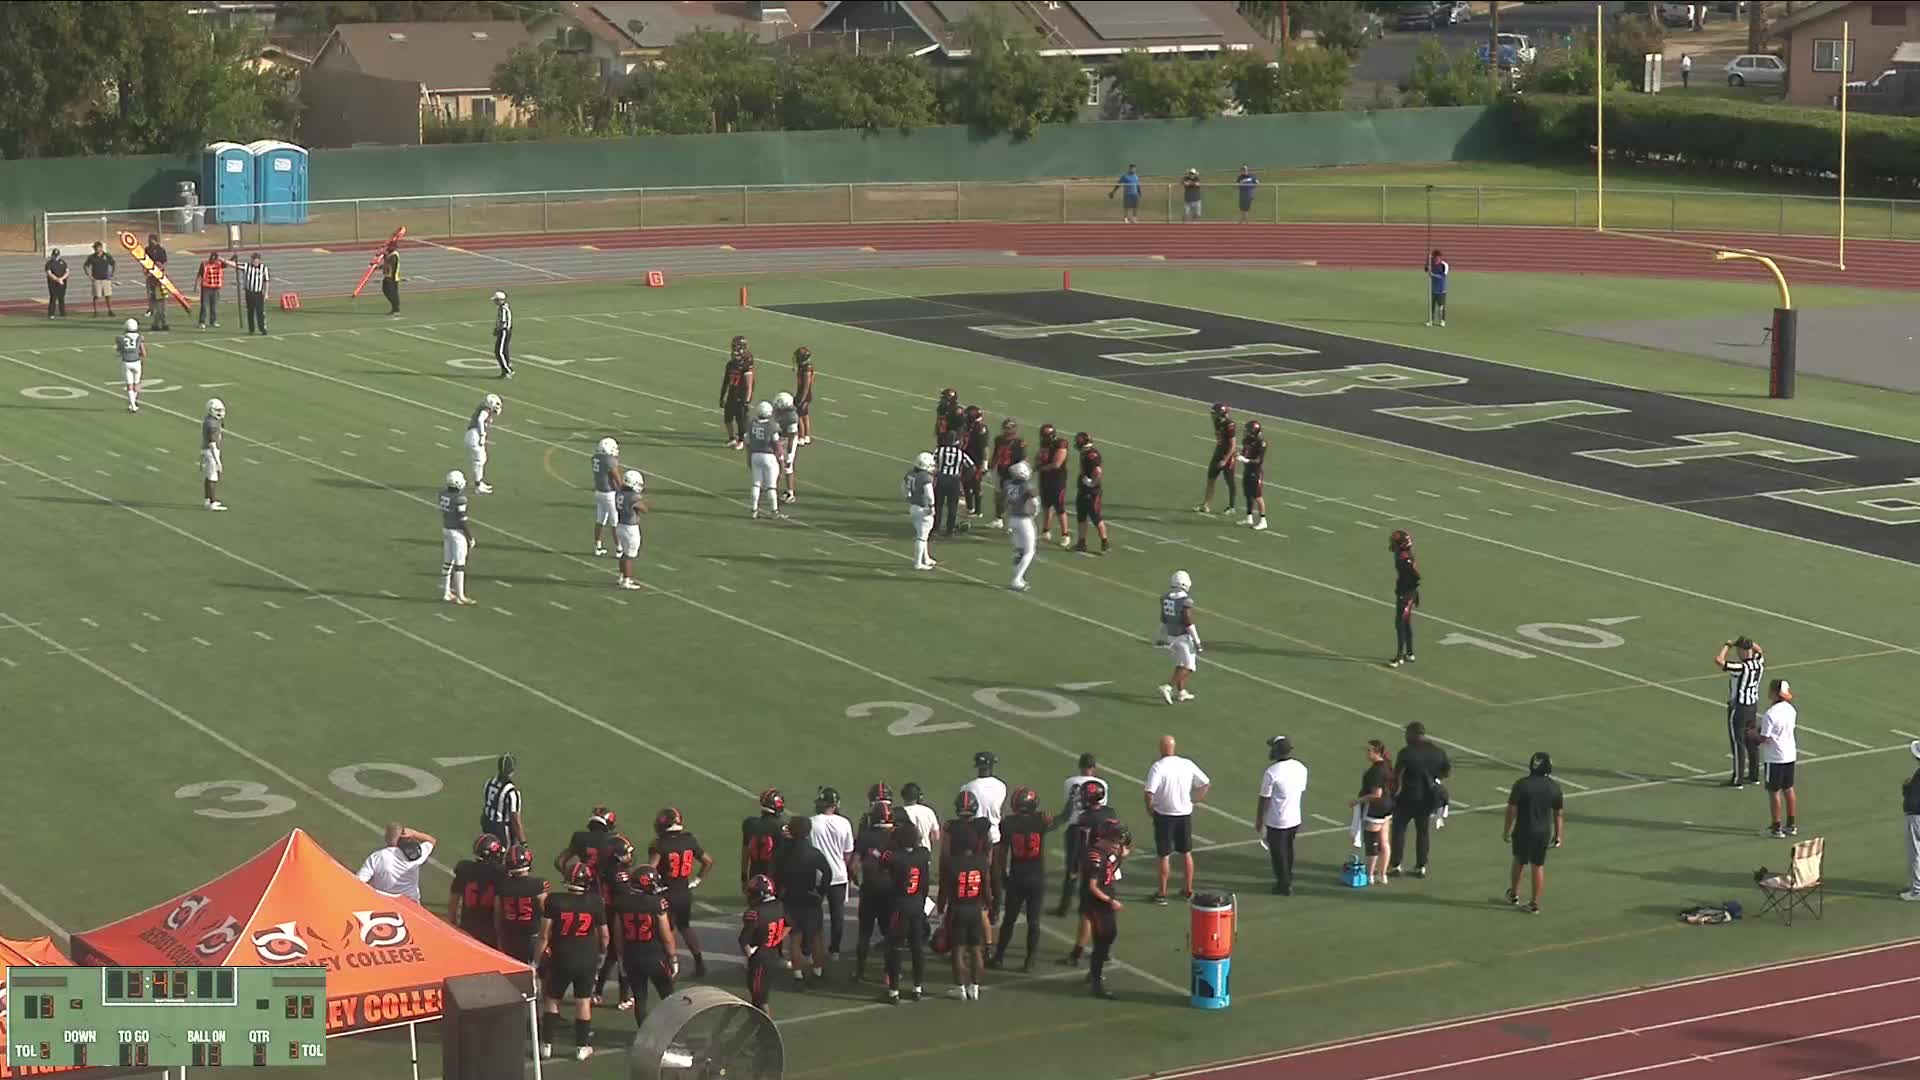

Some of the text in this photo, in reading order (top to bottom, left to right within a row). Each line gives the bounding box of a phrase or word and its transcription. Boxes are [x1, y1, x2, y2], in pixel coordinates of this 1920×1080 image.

[124, 337, 137, 349] 33
[1436, 622, 1625, 659] 10
[845, 687, 1081, 736] 20
[174, 762, 444, 818] 30
[668, 850, 693, 879] 38
[958, 870, 982, 897] 19
[560, 912, 593, 937] 72
[346, 947, 425, 968] COLLEGE
